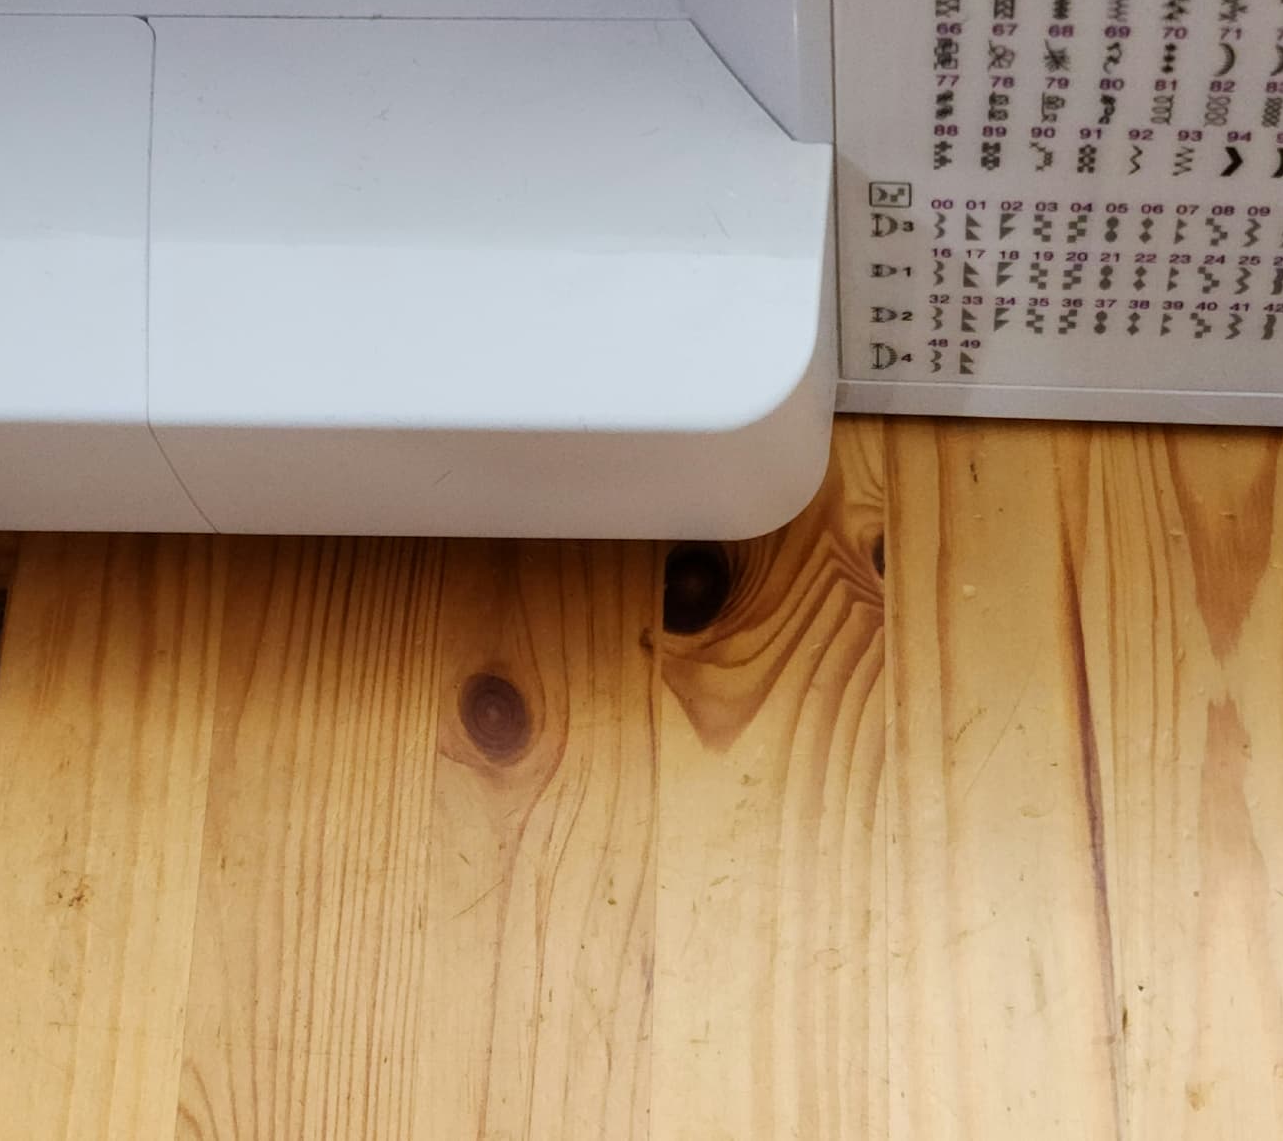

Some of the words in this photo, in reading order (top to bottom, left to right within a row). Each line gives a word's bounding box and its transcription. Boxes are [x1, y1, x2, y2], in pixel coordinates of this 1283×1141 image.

[935, 23, 962, 35] 66
[992, 24, 1018, 36] 67
[1048, 25, 1075, 38] 68
[1104, 25, 1131, 38] 69
[1162, 27, 1188, 40] 70
[1219, 28, 1243, 40] 71
[935, 75, 960, 88] 77
[990, 76, 1015, 89] 78
[1045, 77, 1070, 90] 79
[1099, 78, 1125, 91] 80
[1154, 79, 1178, 92] 81
[1209, 81, 1236, 93] 82
[933, 125, 959, 137] 88
[982, 126, 1007, 138] 89
[1031, 127, 1056, 139] 90
[1080, 128, 1103, 140] 91
[1128, 129, 1154, 141] 92
[1177, 130, 1203, 142] 93
[1226, 131, 1253, 143] 94
[931, 199, 954, 210] 00
[966, 199, 988, 211] 01
[1000, 200, 1024, 212] 02
[1035, 201, 1059, 213] 03
[1070, 202, 1094, 213] 04
[1105, 202, 1129, 214] 05
[1140, 203, 1165, 215] 06
[1176, 204, 1200, 216] 07
[1211, 205, 1235, 217] 08
[1247, 206, 1272, 217] 09
[903, 221, 915, 232] 3
[932, 248, 953, 259] 16
[967, 249, 987, 260] 17
[999, 250, 1020, 261] 18
[1034, 250, 1055, 262] 19
[1066, 251, 1089, 262] 20
[1100, 252, 1121, 263] 21
[1134, 253, 1158, 264] 22
[1169, 254, 1192, 265] 23
[1203, 255, 1226, 265] 24
[1238, 255, 1262, 266] 25
[903, 266, 912, 277] 1
[929, 295, 950, 305] 32
[962, 296, 983, 306] 33
[995, 297, 1016, 306] 34
[1028, 297, 1050, 307] 35
[1061, 298, 1084, 308] 36
[1095, 299, 1116, 309] 37
[1128, 300, 1151, 310] 38
[1163, 300, 1184, 310] 39
[1195, 301, 1218, 311] 40
[1229, 302, 1251, 312] 41
[901, 310, 913, 321] 2
[928, 339, 949, 349] 48
[960, 339, 982, 349] 49
[901, 354, 913, 363] 4
